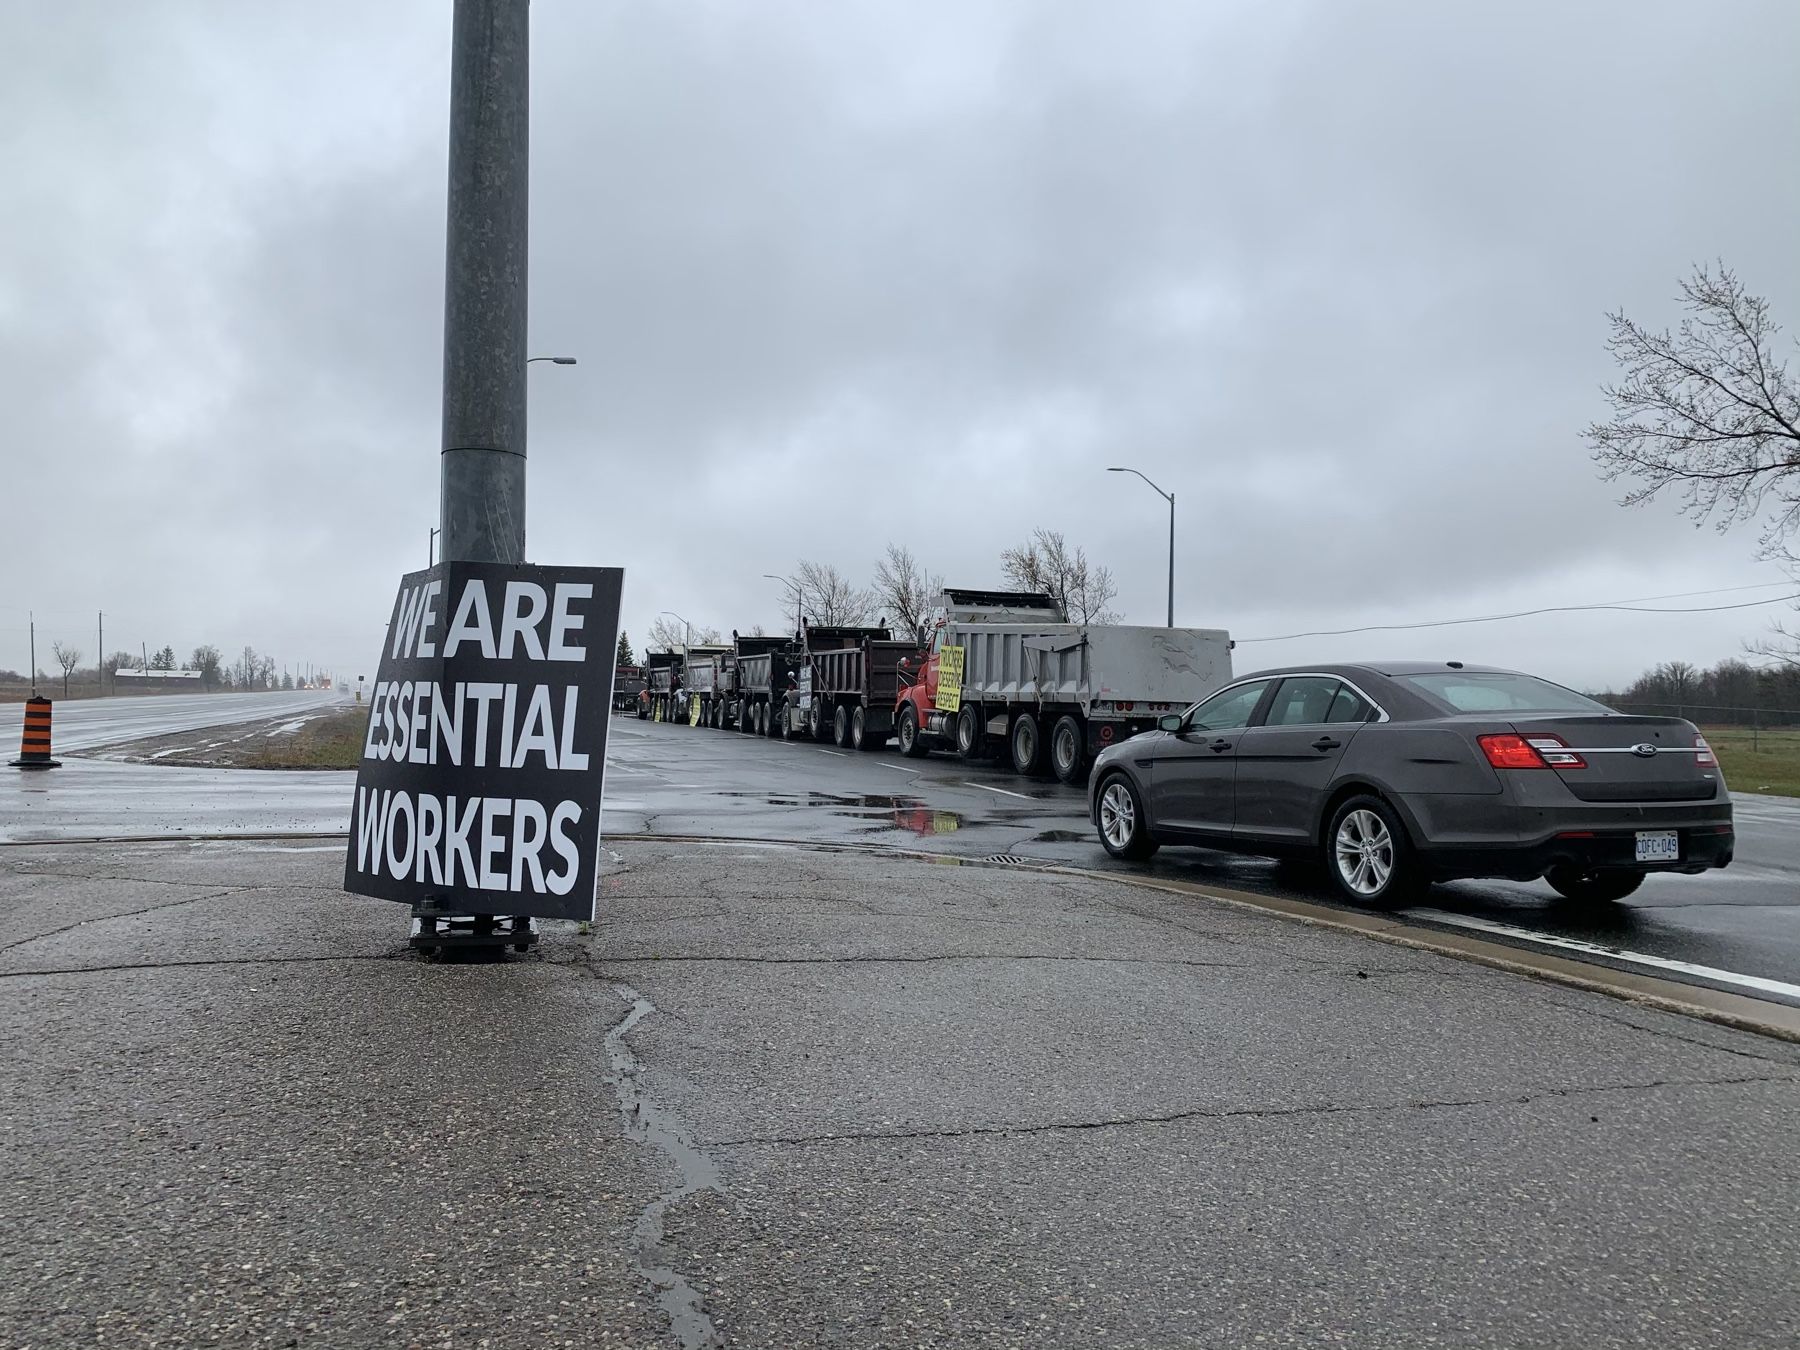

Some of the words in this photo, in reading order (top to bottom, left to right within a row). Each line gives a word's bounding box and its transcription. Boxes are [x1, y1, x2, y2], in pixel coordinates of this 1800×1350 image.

[391, 579, 442, 660] WE
[442, 579, 594, 662] ARE
[938, 691, 959, 709] RESPECT
[939, 671, 961, 689] DESERVE
[363, 681, 590, 771] ESSENTIAL
[357, 786, 583, 896] WORKERS
